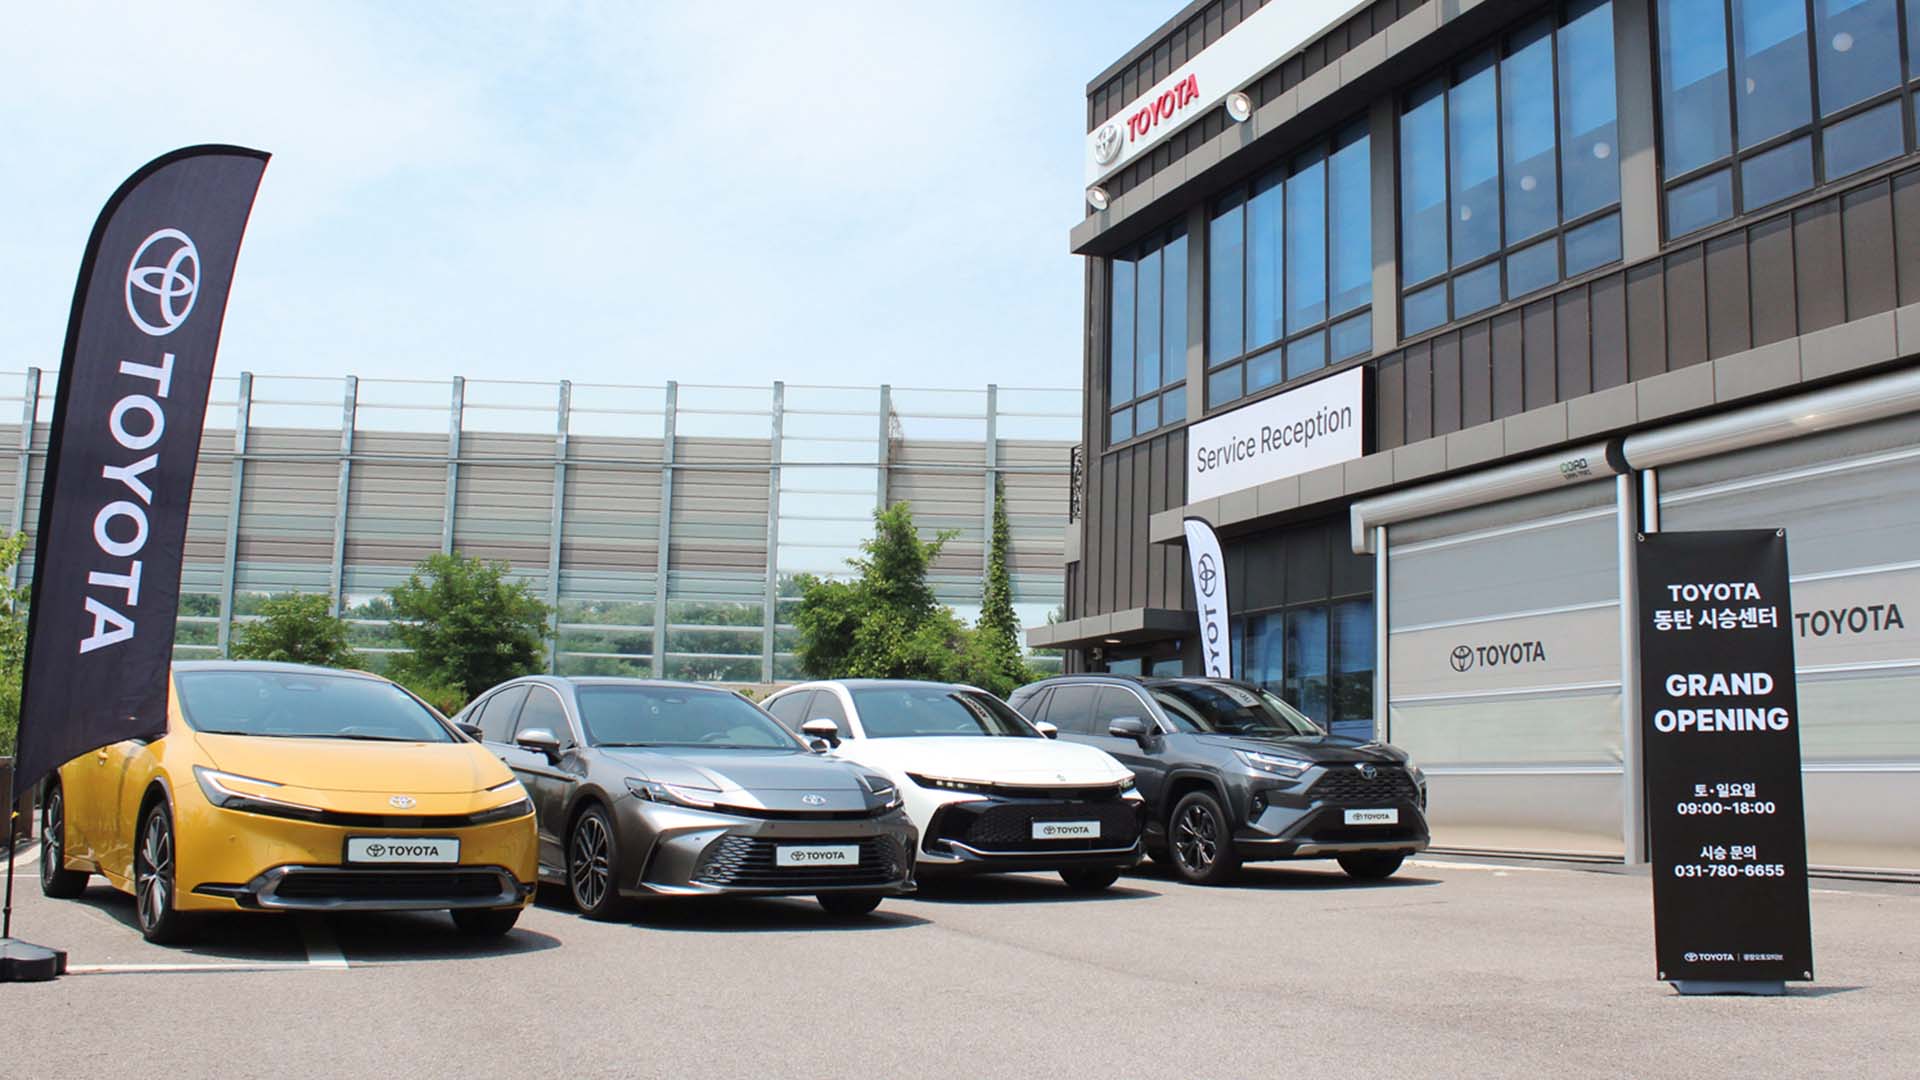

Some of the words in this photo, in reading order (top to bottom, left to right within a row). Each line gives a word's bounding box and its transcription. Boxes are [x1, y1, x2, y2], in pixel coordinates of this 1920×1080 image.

[1127, 73, 1200, 142] TOYOTA
[1196, 436, 1256, 474] Service
[1260, 404, 1353, 456] Reception
[79, 352, 176, 655] TOYOTA
[1667, 582, 1761, 602] TOYOTA
[1653, 609, 1692, 631] 동탄
[1698, 606, 1778, 631] 시승센터
[1795, 603, 1905, 638] TOYOTA
[1476, 640, 1546, 667] TOYOTA
[1665, 672, 1774, 697] GRAND
[1654, 707, 1790, 733] OPENING
[1677, 801, 1776, 815] 09:00~18:00
[1056, 826, 1089, 834] TOYOTA
[388, 846, 439, 856] TOYOTA
[807, 851, 845, 860] TOYOTA
[1700, 845, 1727, 860] 시승
[1730, 845, 1757, 860] 문의
[1674, 863, 1785, 878] 031-780-6655
[1699, 953, 1735, 962] TOYOTA
